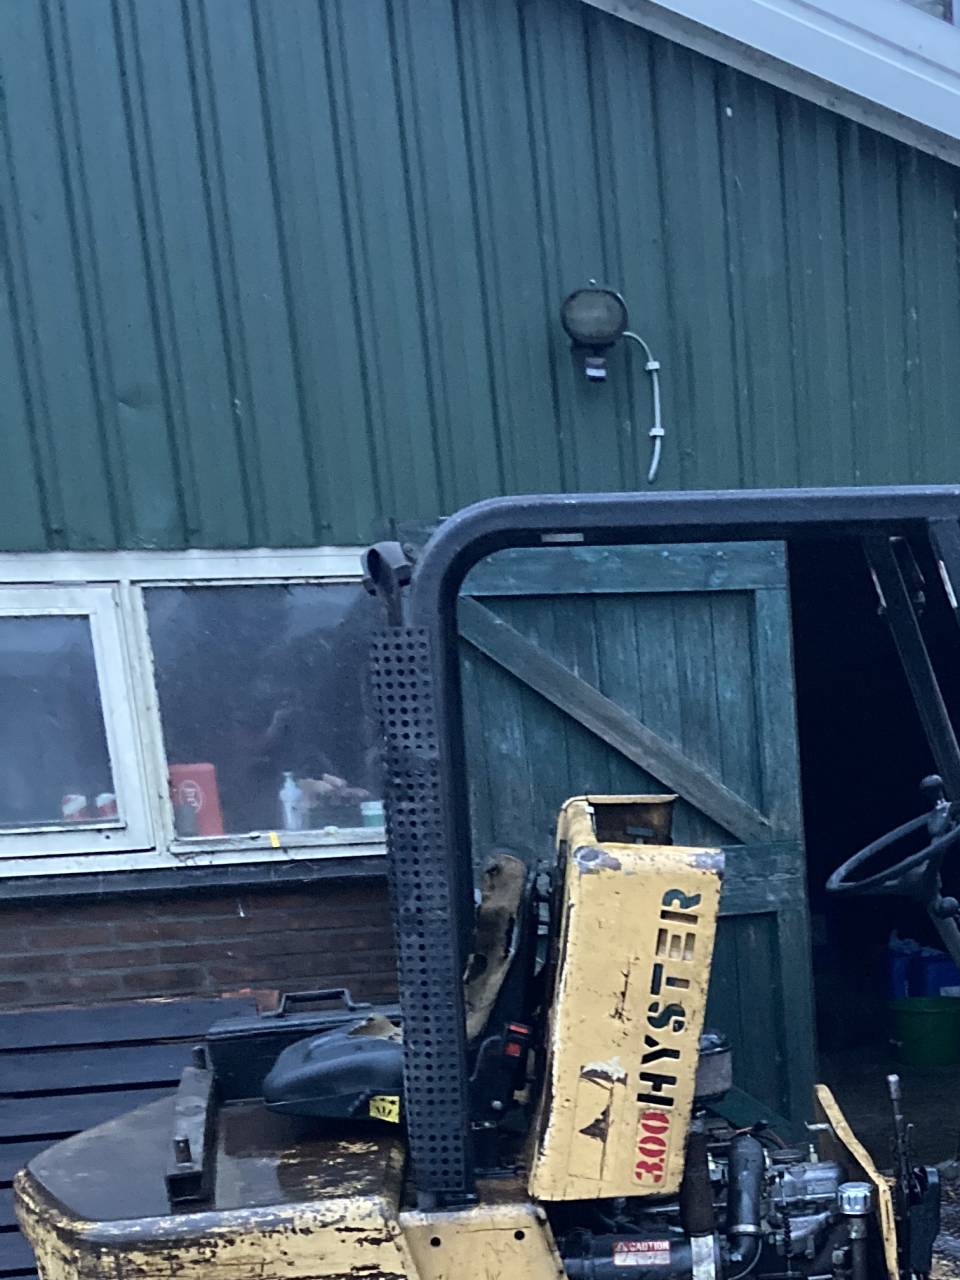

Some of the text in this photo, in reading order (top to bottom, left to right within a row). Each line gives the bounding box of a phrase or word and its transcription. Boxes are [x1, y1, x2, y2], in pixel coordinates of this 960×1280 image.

[636, 888, 702, 1107] HYSTER
[635, 1109, 670, 1184] 3.00
[630, 1241, 670, 1252] CAUTION
